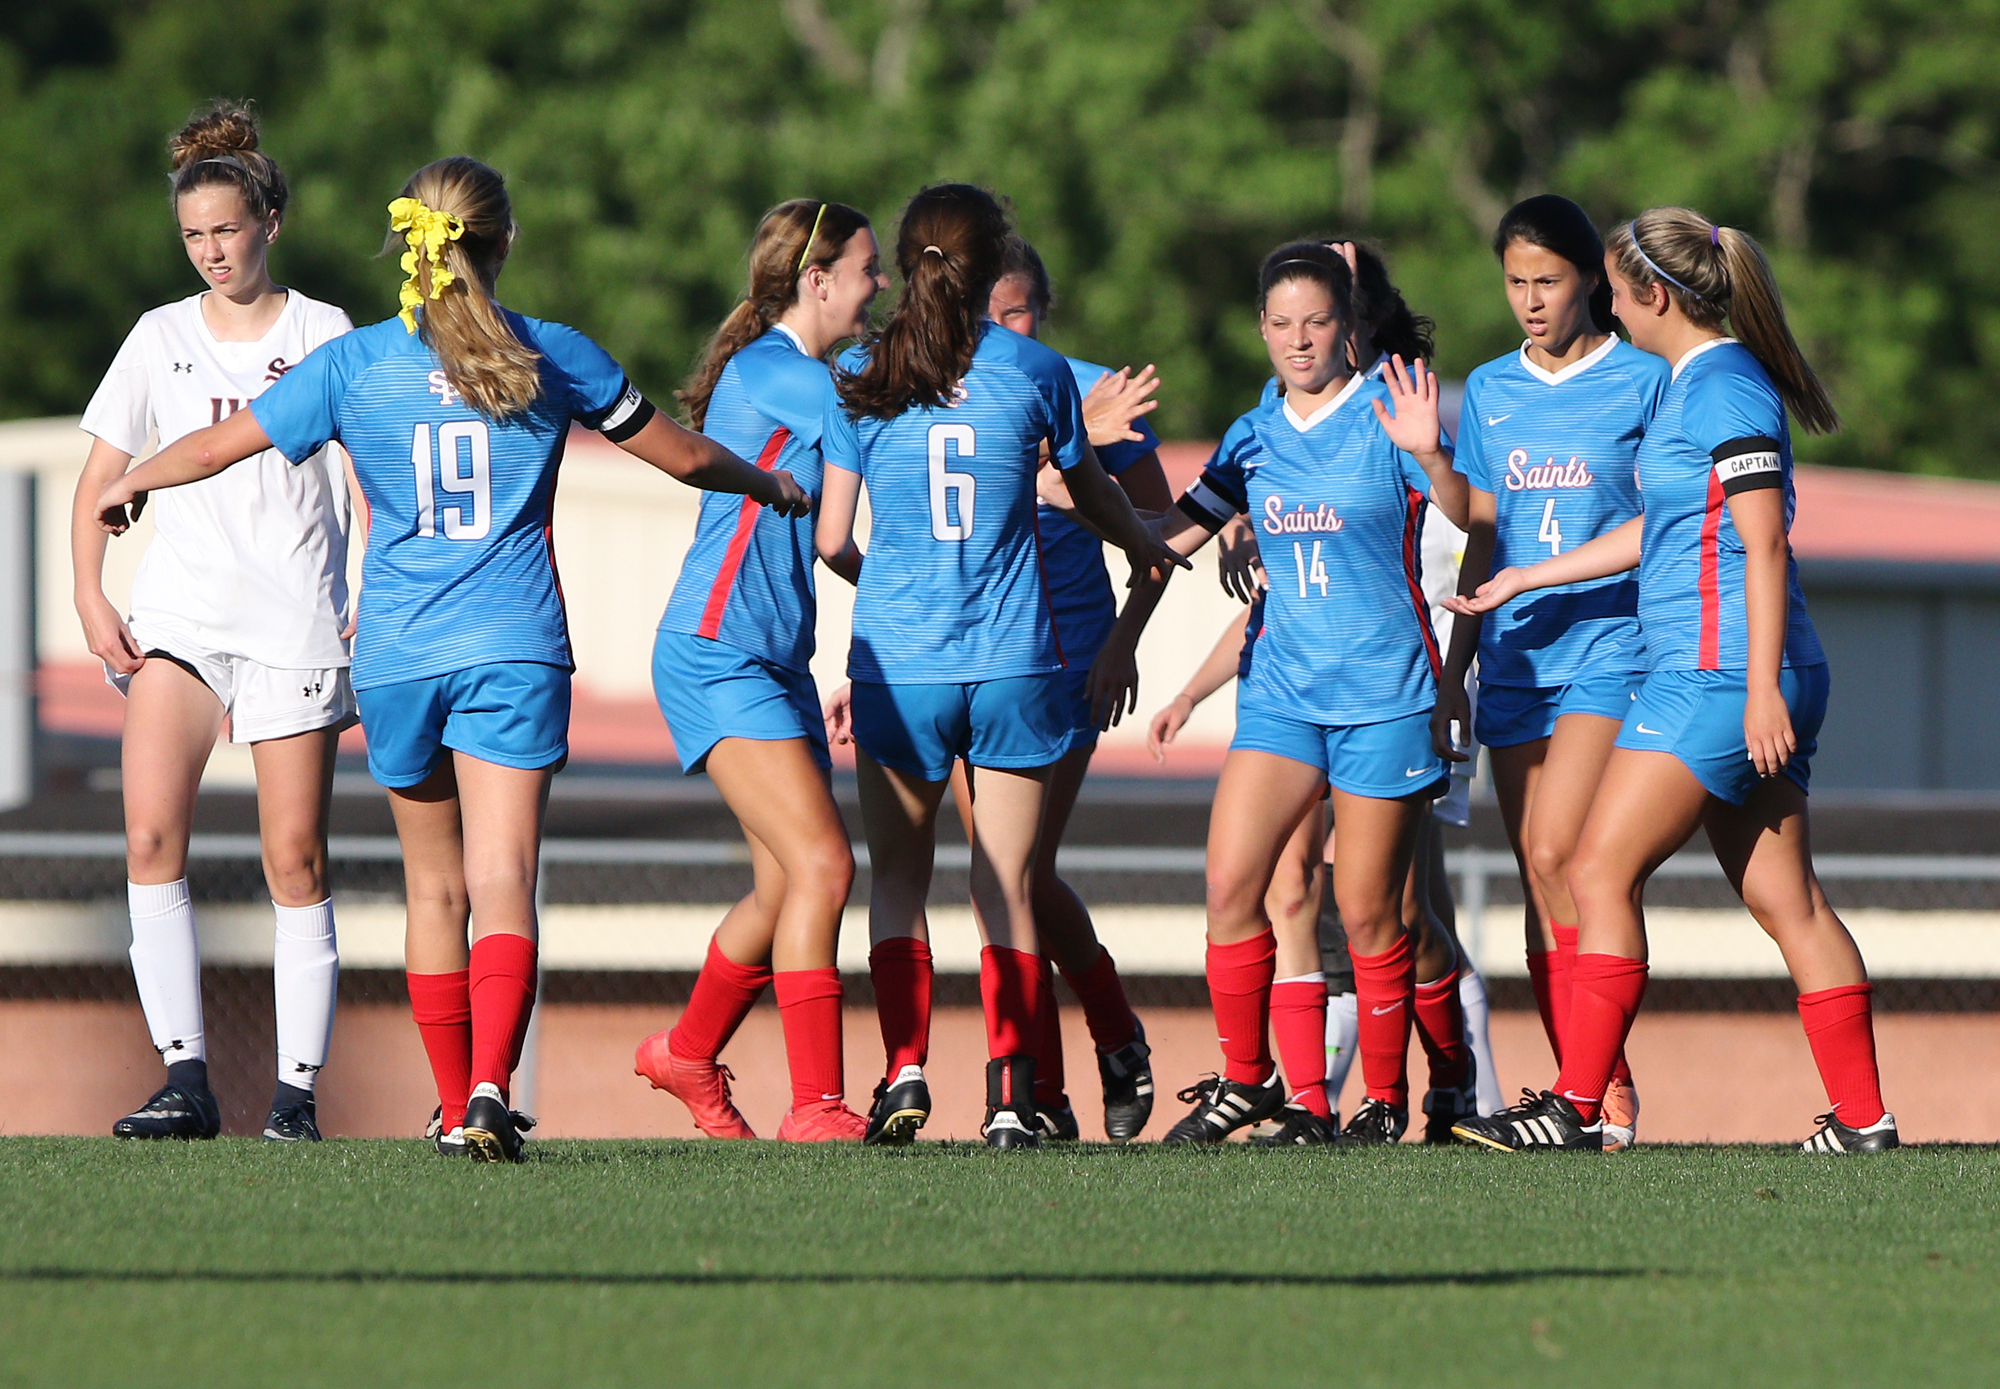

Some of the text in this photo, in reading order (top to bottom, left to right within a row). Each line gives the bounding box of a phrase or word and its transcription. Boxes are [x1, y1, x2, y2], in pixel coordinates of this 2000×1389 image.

[411, 420, 492, 540] 19
[927, 422, 976, 541] 6
[1504, 448, 1594, 491] Saints
[1731, 456, 1779, 473] CAPTAIN
[1263, 494, 1344, 535] Saints
[1538, 498, 1562, 556] 4
[1293, 539, 1329, 598] 14
